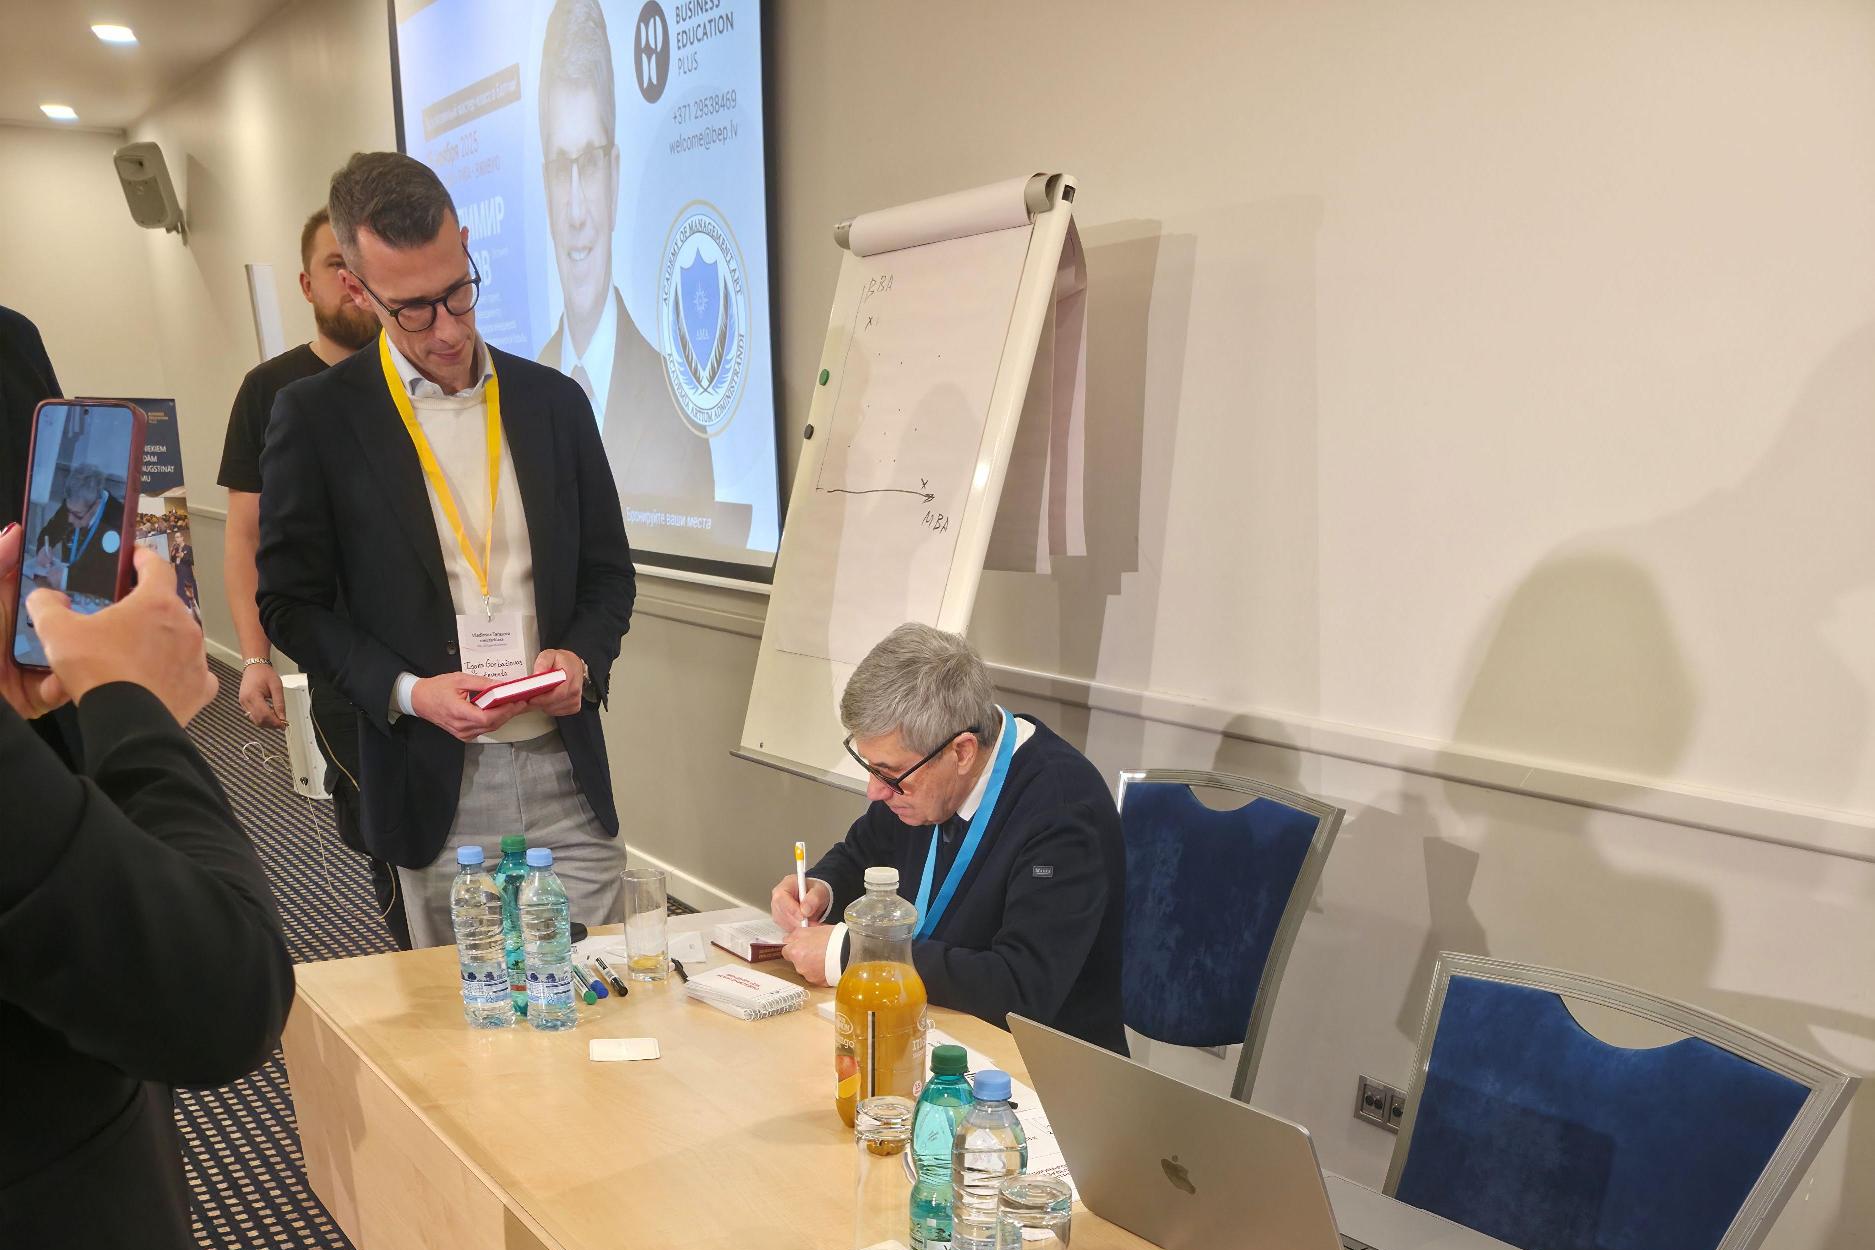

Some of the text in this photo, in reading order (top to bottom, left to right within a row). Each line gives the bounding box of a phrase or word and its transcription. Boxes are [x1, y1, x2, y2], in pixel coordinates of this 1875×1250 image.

[677, 11, 734, 50] EDUCATION
[678, 51, 699, 76] PLUS
[673, 89, 737, 125] +371 29538469
[669, 120, 738, 155] welcome@bep.lv
[688, 217, 734, 264] MANAGEMENT
[687, 515, 712, 530] места
